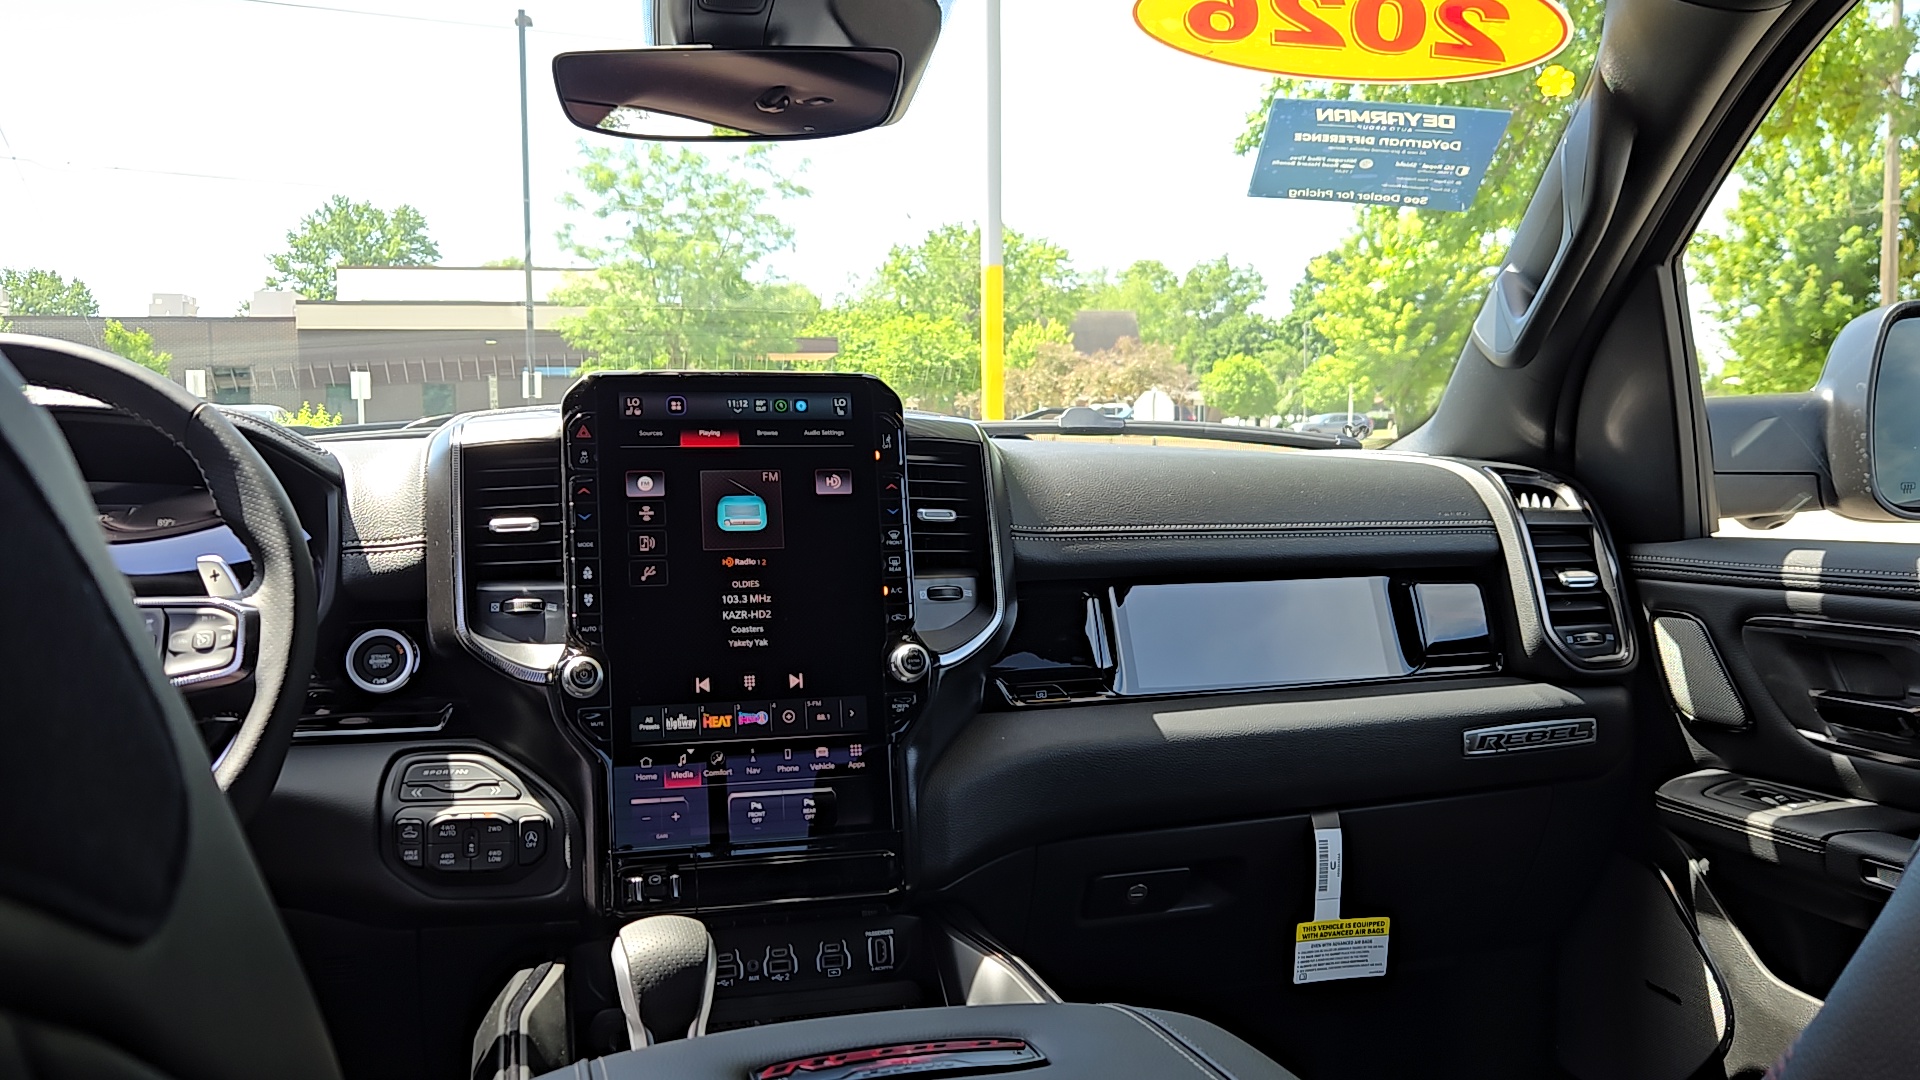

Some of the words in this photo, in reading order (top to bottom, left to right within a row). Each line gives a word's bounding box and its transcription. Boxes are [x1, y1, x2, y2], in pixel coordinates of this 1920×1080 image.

[626, 397, 641, 407] LO
[727, 399, 749, 408] 11:12
[833, 398, 847, 407] LO
[638, 429, 664, 437] Sources
[698, 429, 721, 438] Playing
[756, 429, 779, 437] Browse
[821, 429, 845, 437] Settings
[762, 471, 779, 482] FM
[735, 558, 757, 566] Radio
[731, 580, 761, 589] OLDIES
[890, 586, 903, 594] A/C
[722, 594, 748, 605] 103.3
[750, 594, 772, 603] MHz
[722, 610, 772, 620] KAZR-HD2
[730, 626, 765, 634] Coasters
[728, 639, 754, 648] Yakety
[754, 638, 769, 646] Yak
[666, 716, 698, 730] highway
[702, 714, 732, 728] HEAT
[1476, 722, 1594, 751] REBEL
[776, 765, 800, 773] Phone
[810, 762, 836, 771] Vehicle
[848, 761, 866, 770] Apps
[671, 770, 694, 779] Media
[702, 768, 733, 778] Comfort
[746, 766, 761, 775] Nav
[748, 810, 766, 818] FRONT
[752, 816, 762, 824] OFF
[1318, 923, 1344, 931] VEHICLE
[1353, 920, 1386, 928] EQUIPPED
[1302, 932, 1318, 940] WITH
[1320, 930, 1354, 938] ADVANCED
